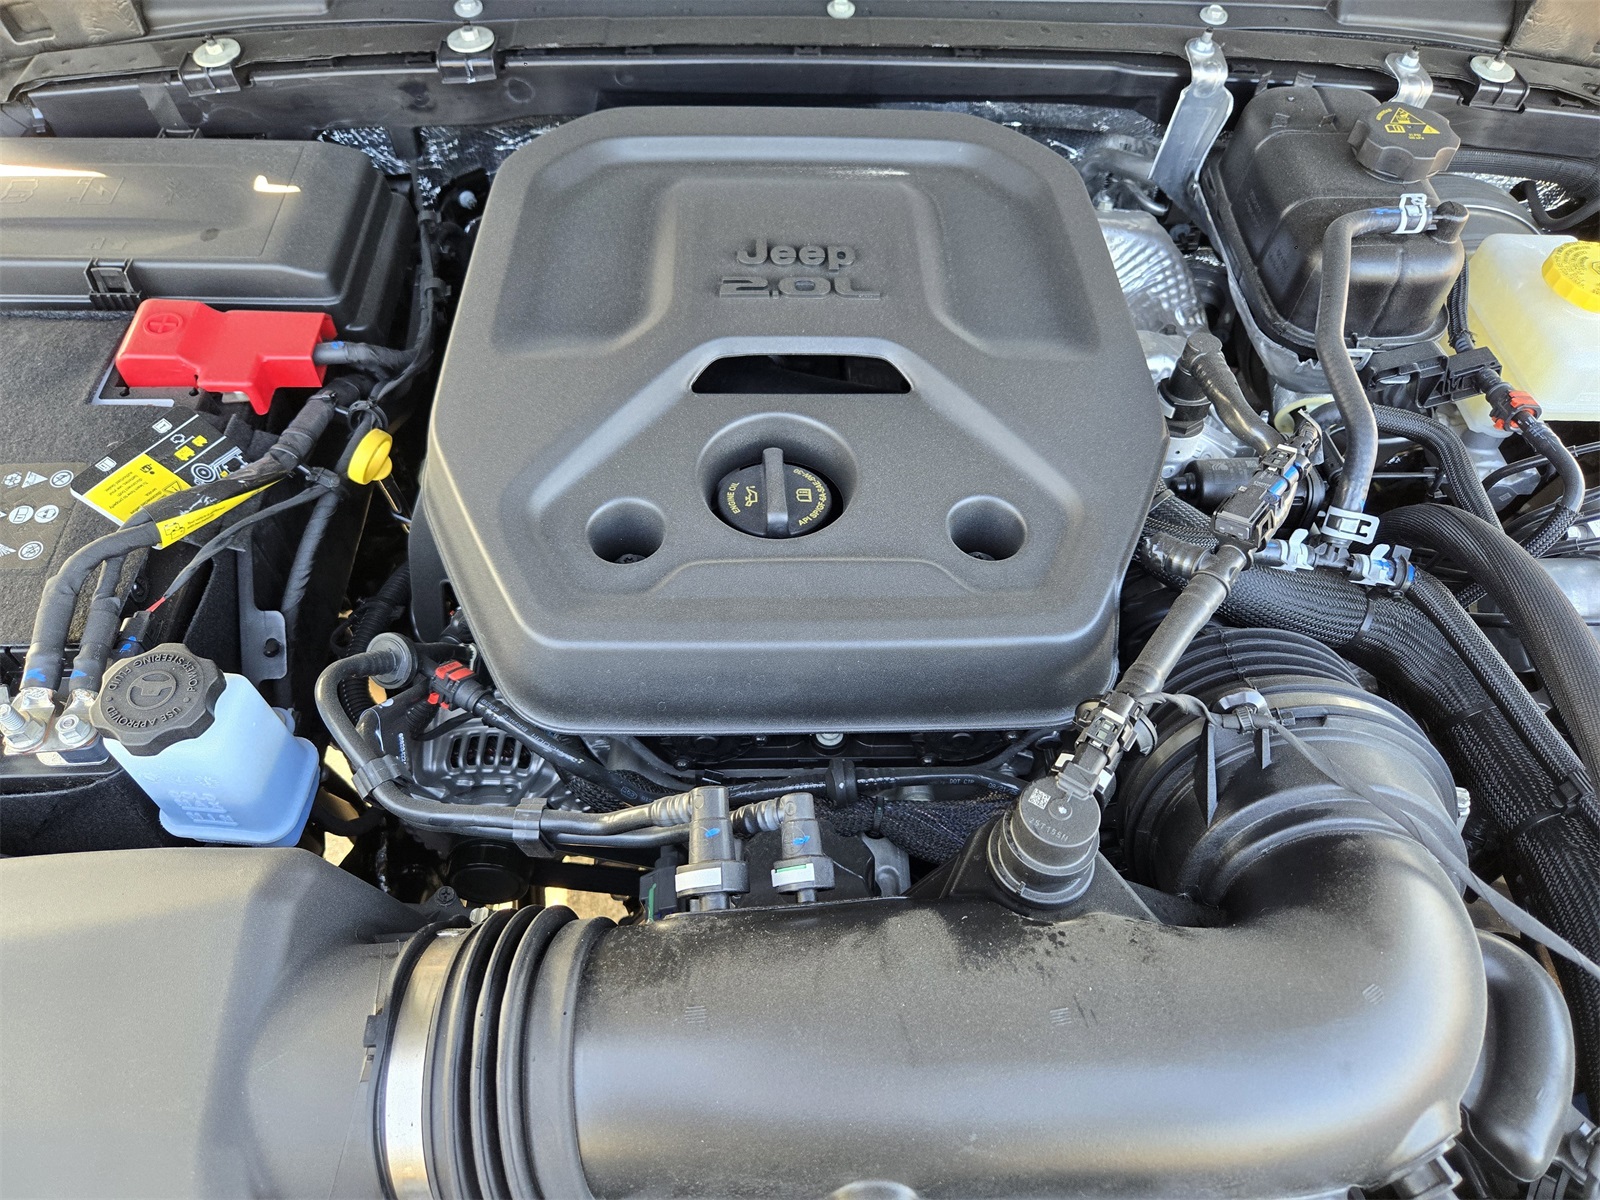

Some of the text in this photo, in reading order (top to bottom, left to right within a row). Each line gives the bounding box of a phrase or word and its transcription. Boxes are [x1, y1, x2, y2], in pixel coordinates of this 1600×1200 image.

[737, 239, 855, 272] Jeep
[720, 277, 880, 299] 2.0L
[727, 482, 741, 514] ENGINE OIL
[798, 516, 812, 526] API
[108, 653, 198, 692] POWER STEERING FLUID
[106, 705, 181, 728] USE APPROVED
